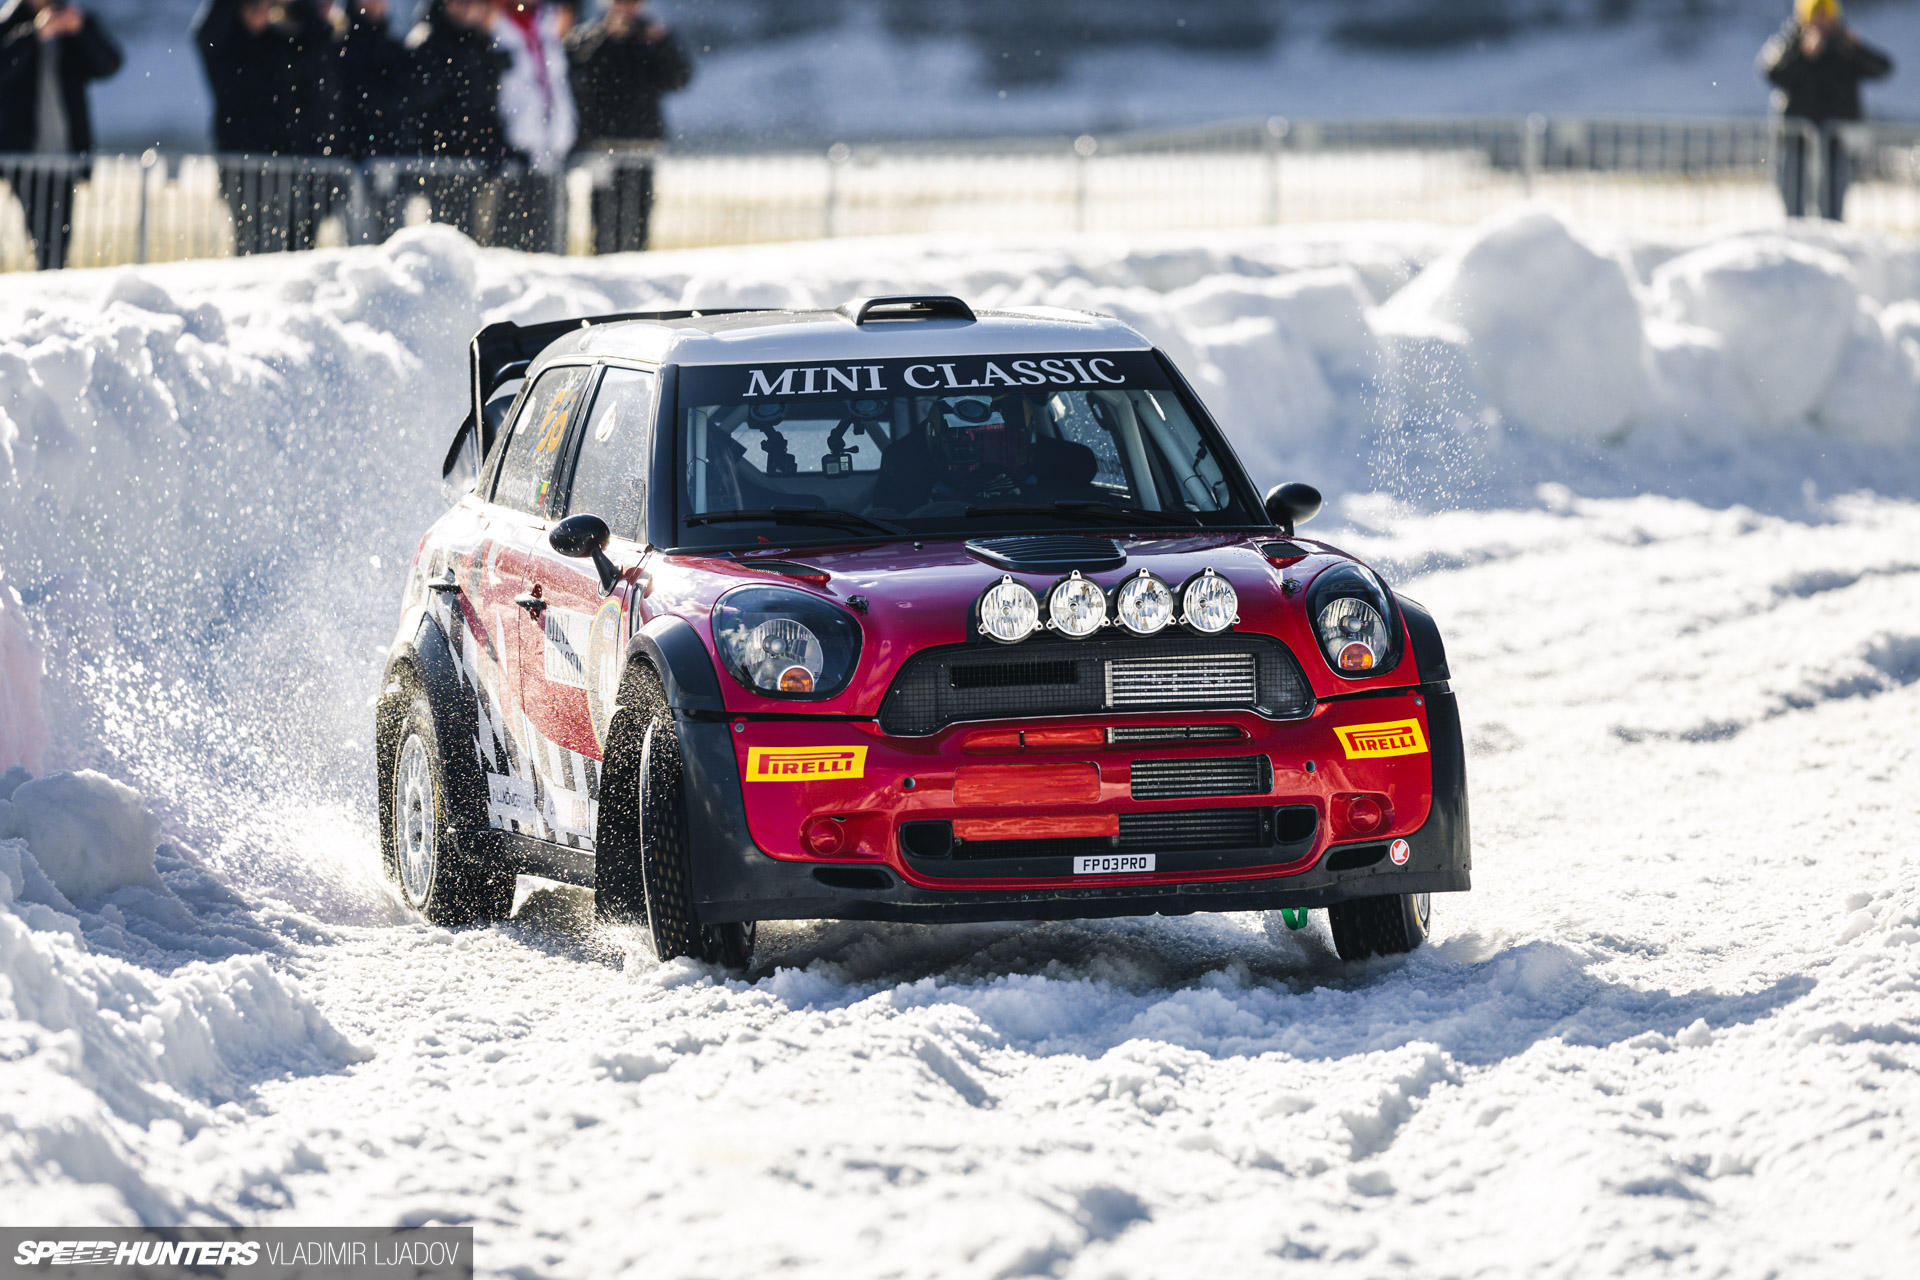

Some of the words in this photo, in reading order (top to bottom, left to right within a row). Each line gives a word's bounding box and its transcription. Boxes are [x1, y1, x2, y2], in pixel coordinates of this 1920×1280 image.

[743, 366, 887, 397] MINI
[903, 357, 1126, 389] CLASSIC
[1344, 726, 1417, 752] PIRELLI
[758, 751, 856, 775] PIRELLI
[1083, 857, 1147, 871] FP03PRO
